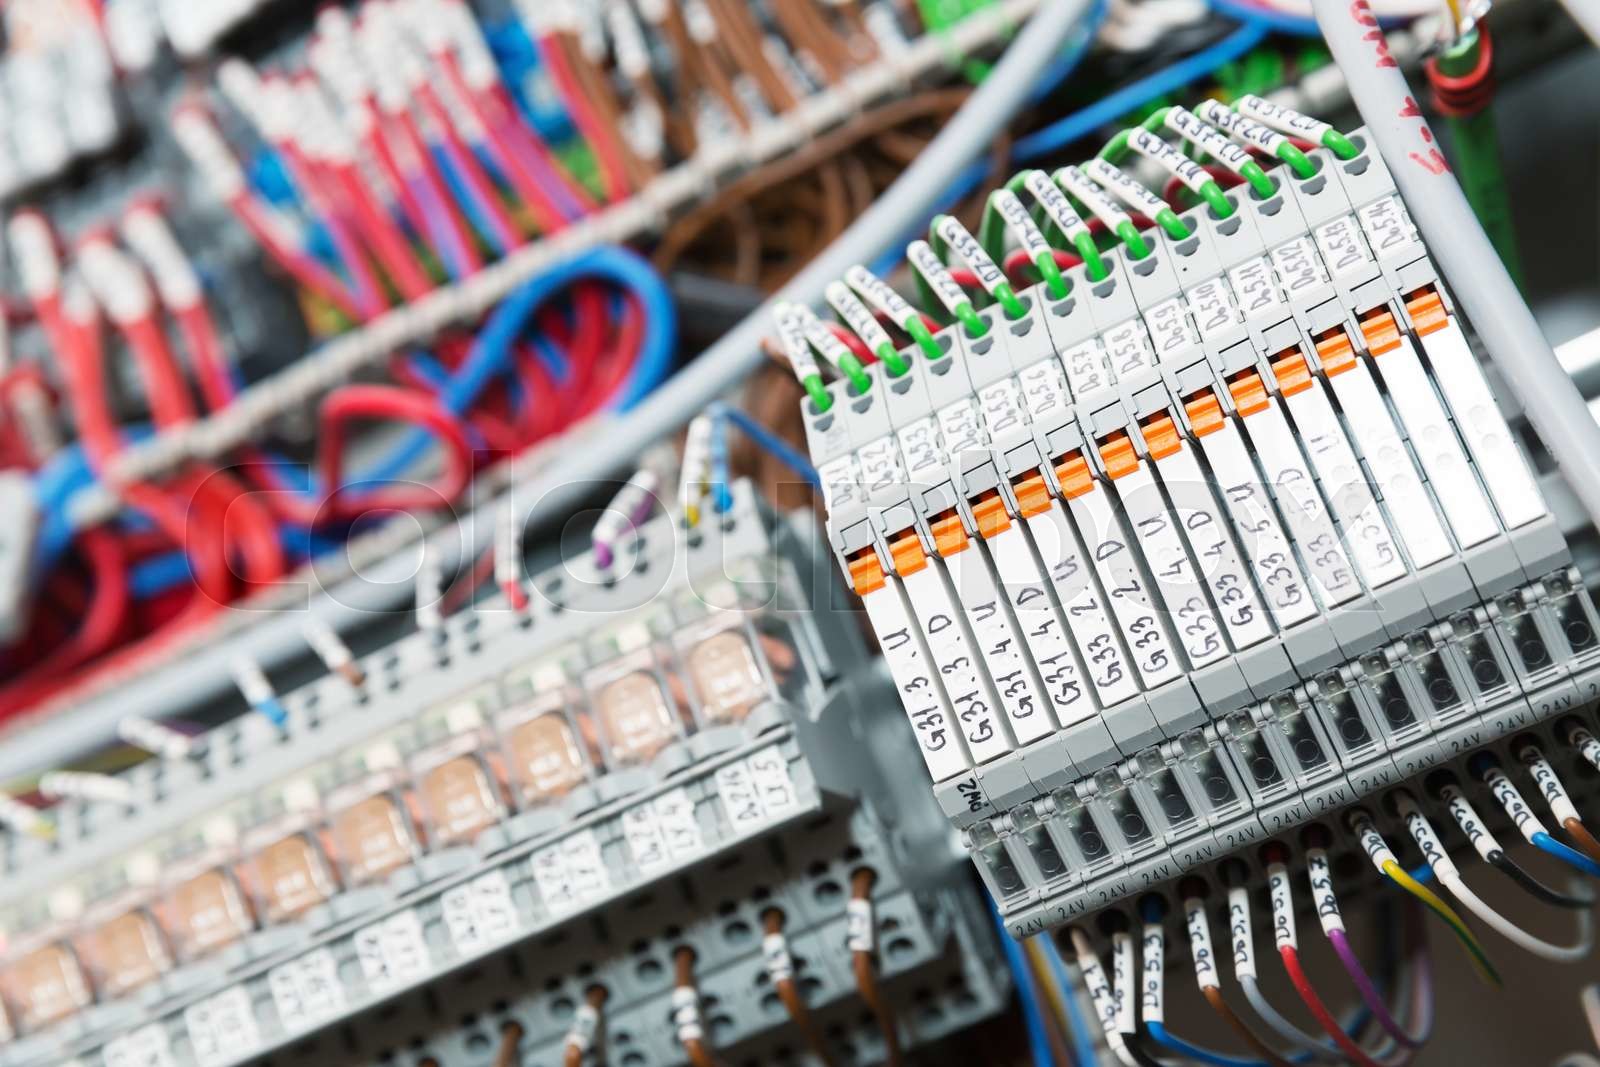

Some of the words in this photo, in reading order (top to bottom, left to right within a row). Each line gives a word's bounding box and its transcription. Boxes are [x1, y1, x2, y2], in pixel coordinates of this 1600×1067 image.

[1542, 695, 1572, 715] 24V
[1496, 712, 1525, 733] 24V
[1451, 732, 1481, 751] 24V
[1406, 754, 1436, 774] 24V
[1360, 772, 1390, 791] 24V
[1316, 788, 1345, 809] 24V
[1273, 807, 1301, 828] 24V
[1227, 828, 1256, 847] 24V
[1184, 846, 1213, 866] 24V
[1142, 865, 1170, 885] 24V
[1099, 883, 1128, 903] 24V
[1057, 902, 1086, 920] 24V
[1016, 917, 1044, 937] 24V
